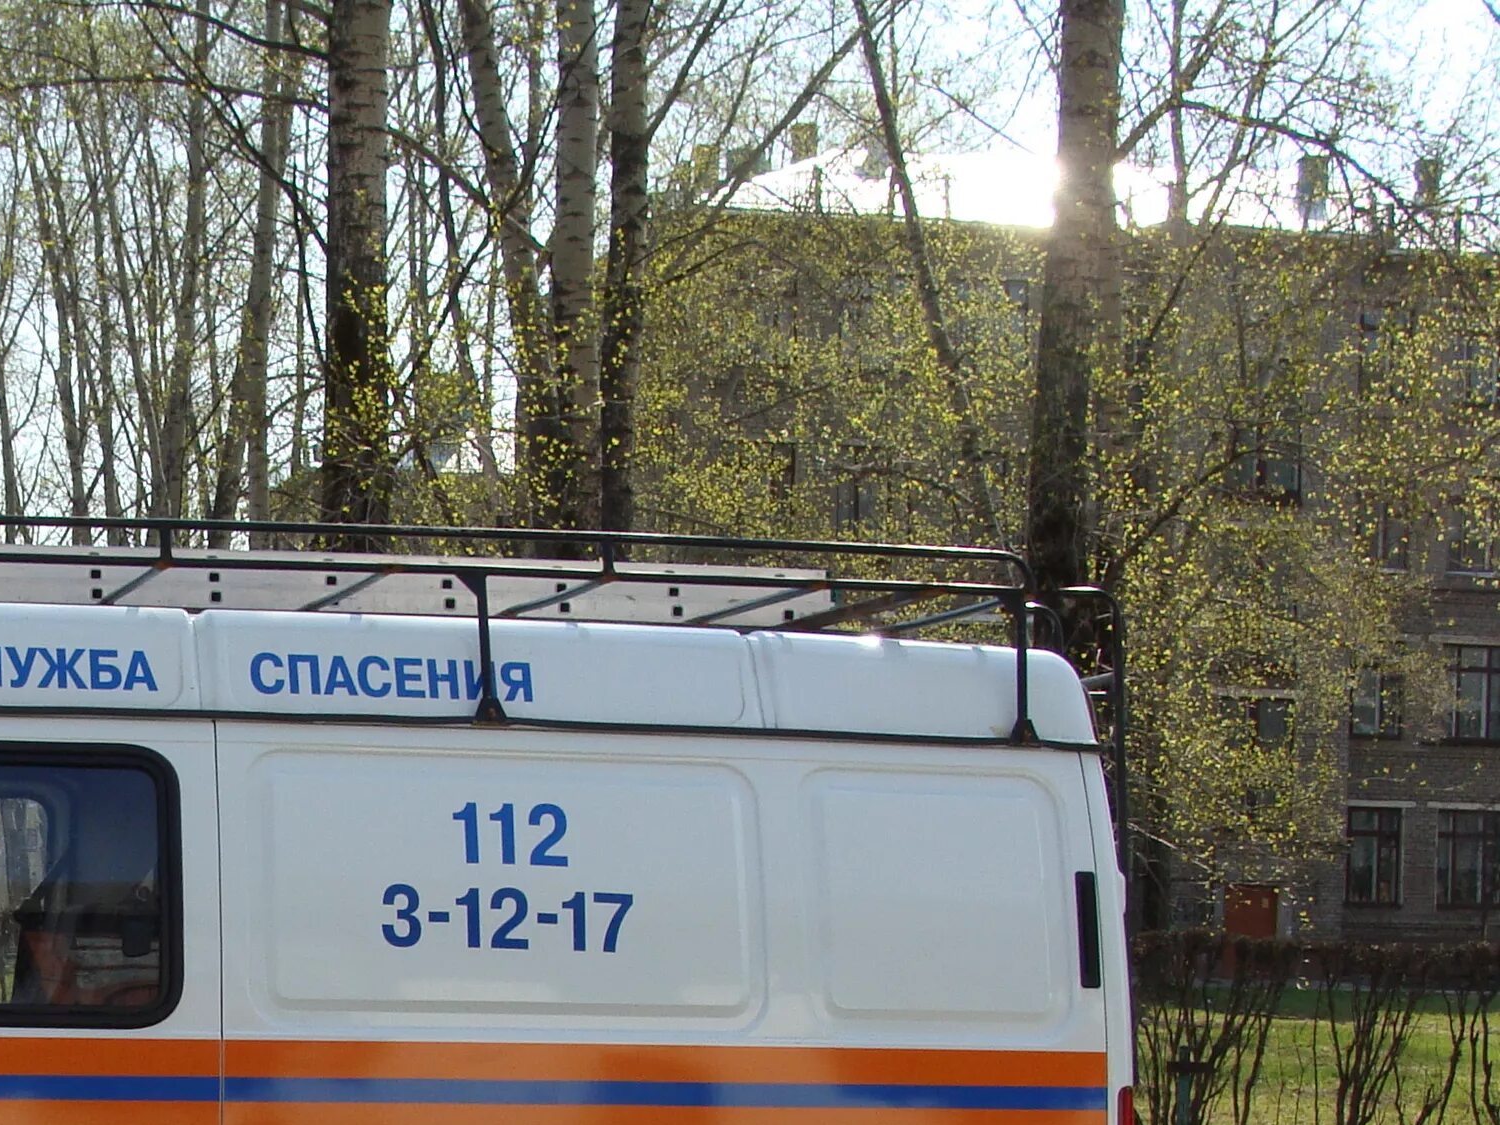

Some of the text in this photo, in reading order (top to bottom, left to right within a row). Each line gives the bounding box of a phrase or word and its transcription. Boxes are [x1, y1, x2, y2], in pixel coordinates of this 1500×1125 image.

[250, 653, 533, 702] СПАСЕНИЯ
[452, 802, 568, 867] 112
[381, 883, 633, 952] 3-12-17
